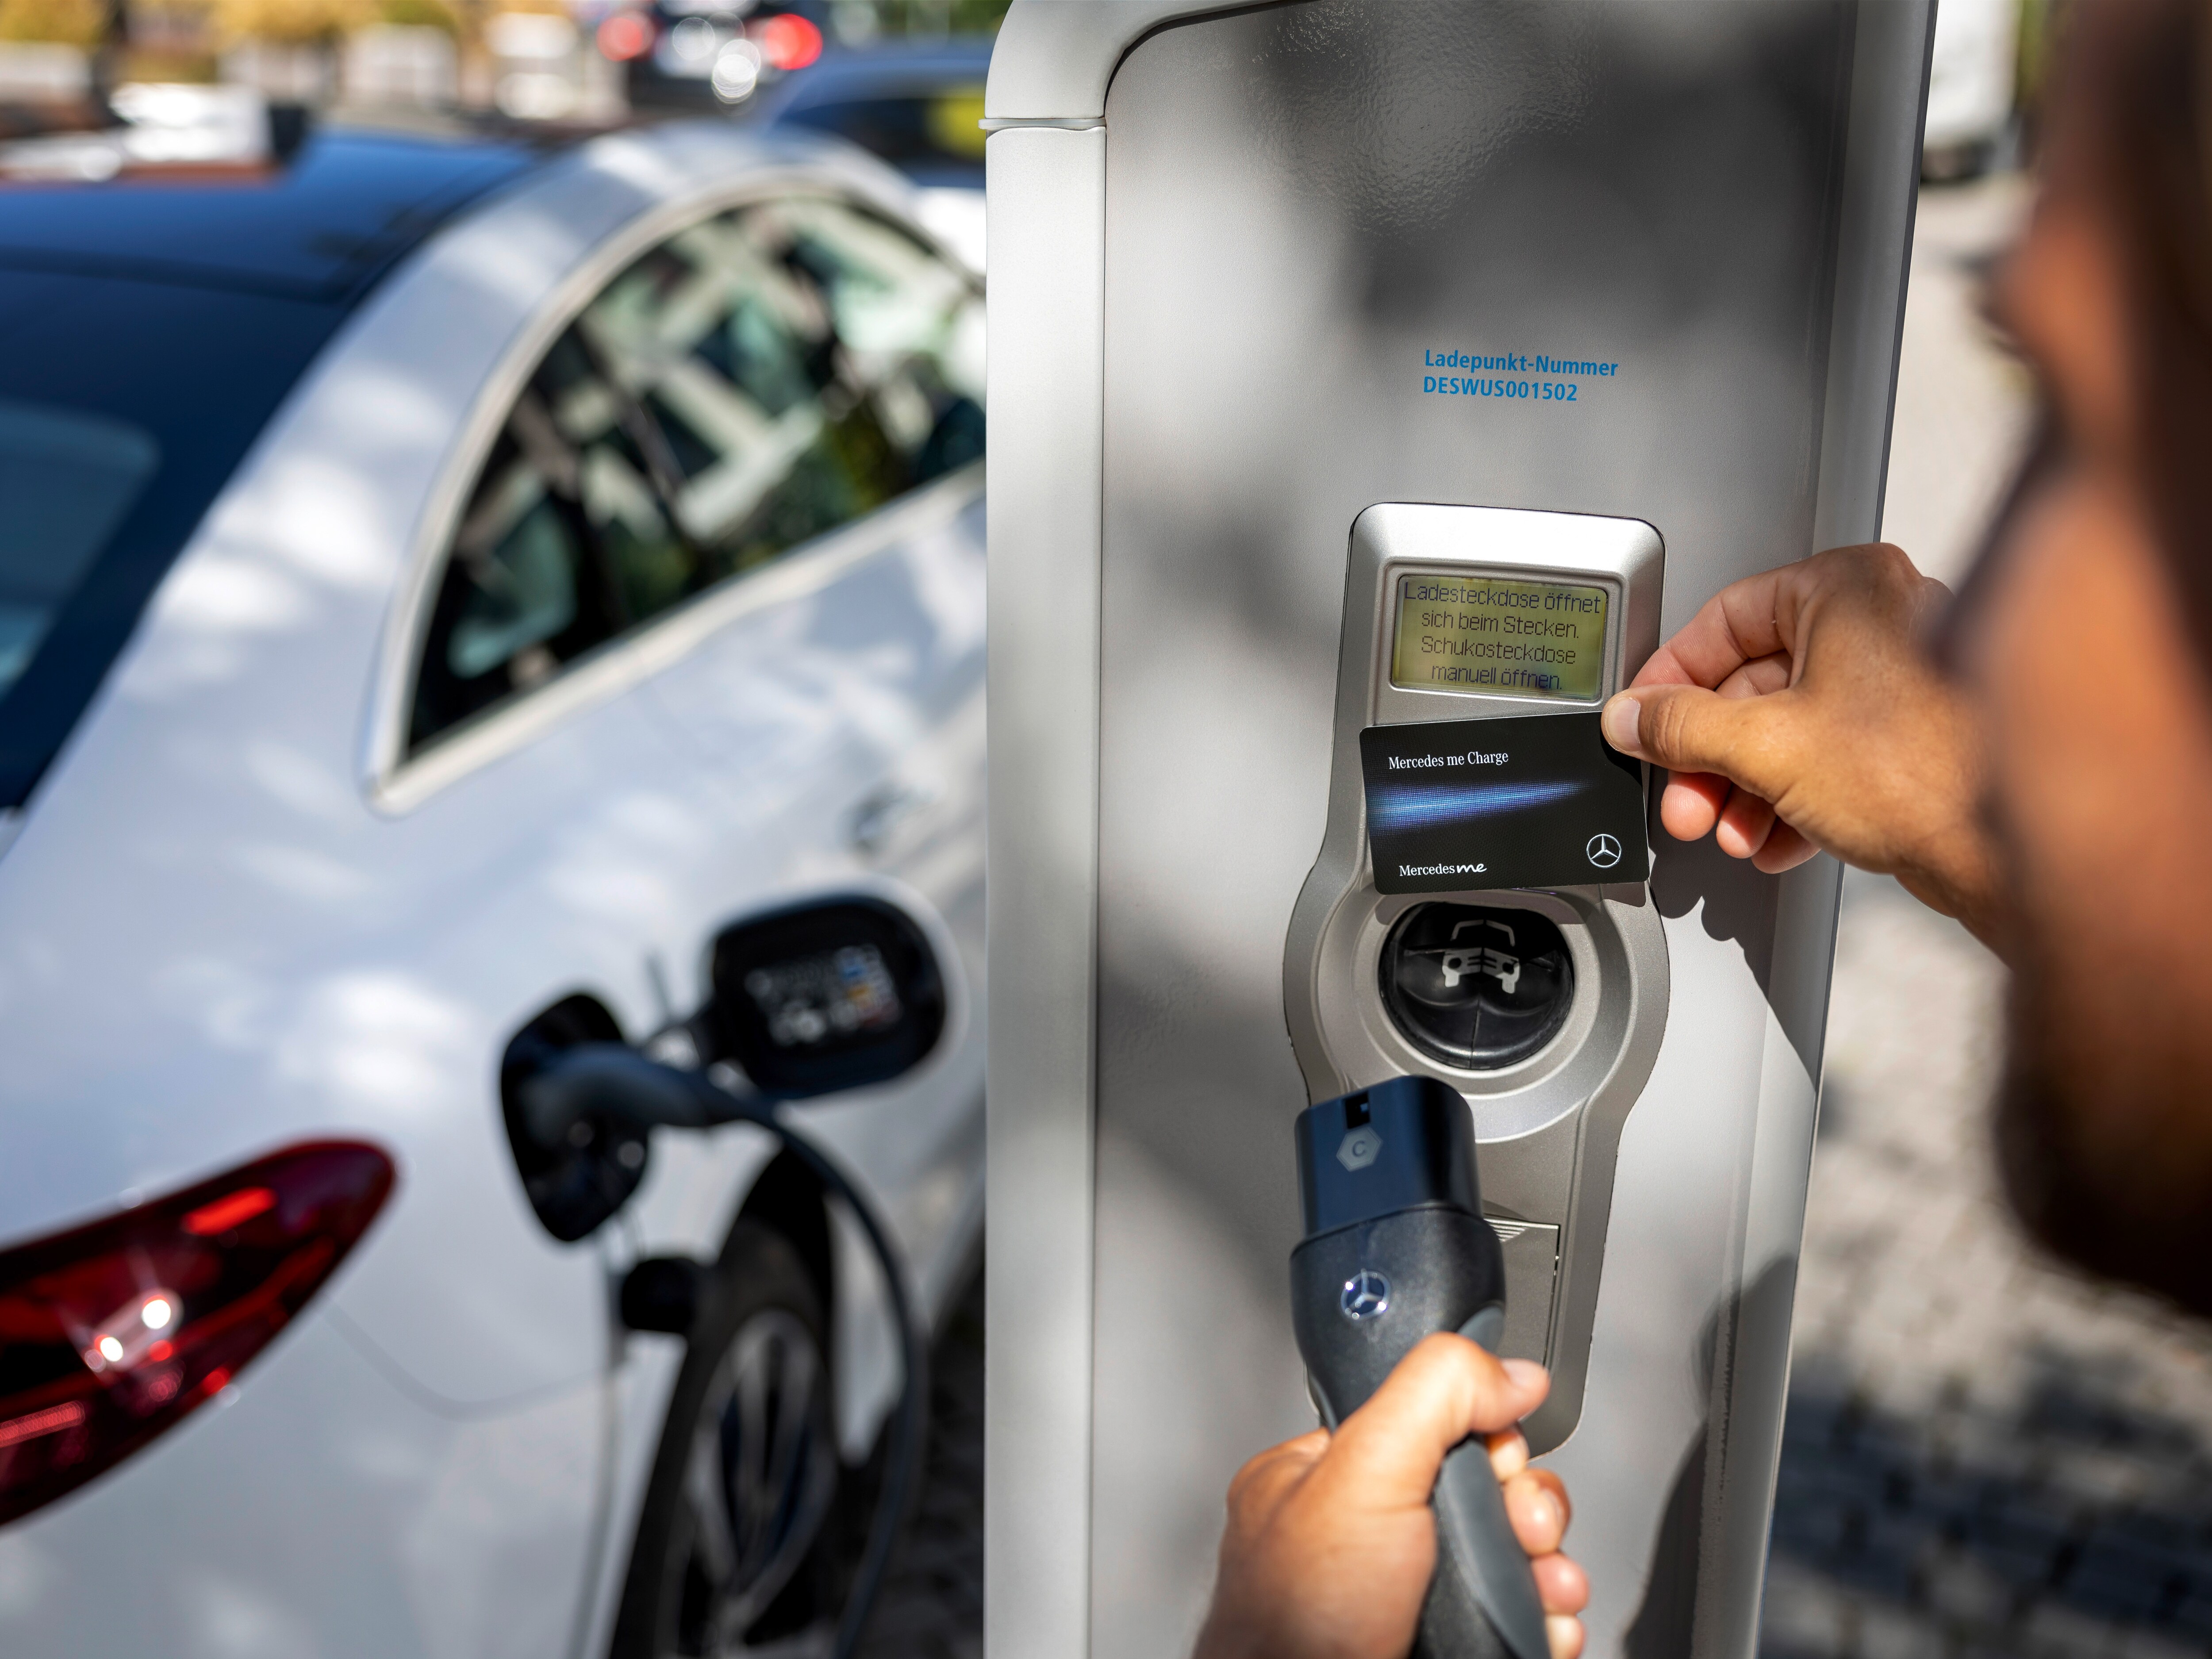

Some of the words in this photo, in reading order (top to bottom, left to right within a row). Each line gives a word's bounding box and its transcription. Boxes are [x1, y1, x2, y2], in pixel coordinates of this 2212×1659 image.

[1425, 349, 1618, 376] Ladepunkt-Nummer
[1424, 376, 1577, 401] DESWUS001502
[1404, 581, 1540, 609] Ladesteckdose
[1544, 592, 1601, 614] öffnet
[1421, 611, 1454, 629] sich
[1458, 612, 1498, 632] beim
[1503, 616, 1579, 639] Stecken.
[1421, 635, 1576, 664] Schukosteckdose
[1432, 665, 1496, 684] manuell
[1501, 668, 1563, 690] öffnen.
[1388, 753, 1444, 769] Mercedes
[1447, 755, 1465, 766] me
[1467, 751, 1509, 766] Charge
[1352, 1140, 1367, 1157] C
